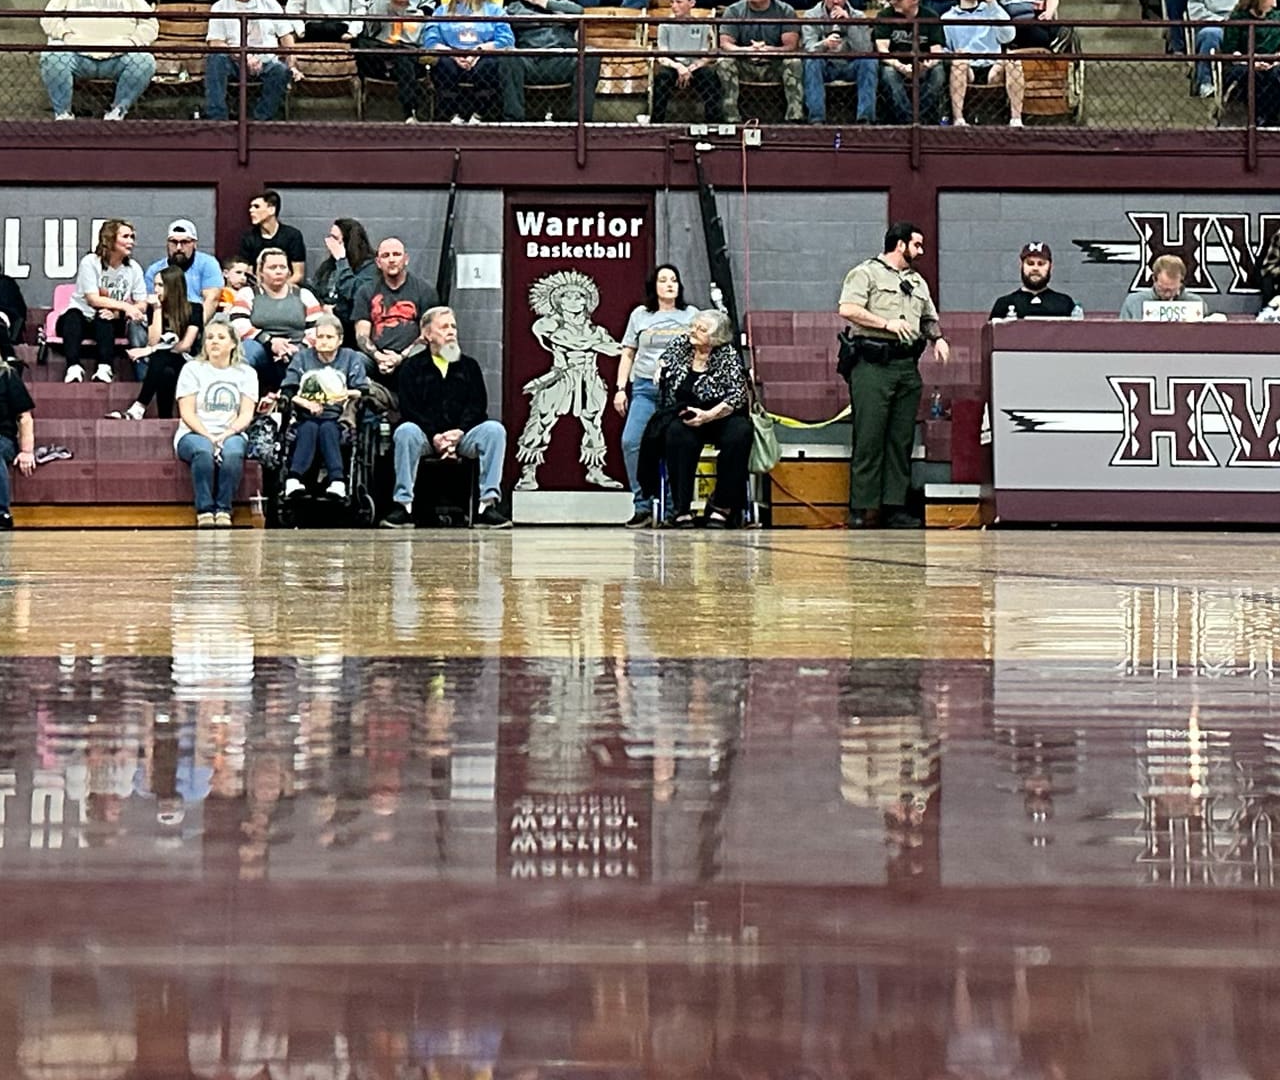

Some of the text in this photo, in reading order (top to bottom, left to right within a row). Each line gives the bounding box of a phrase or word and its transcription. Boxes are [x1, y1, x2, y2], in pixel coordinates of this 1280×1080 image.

[515, 210, 644, 238] Warrior
[526, 241, 632, 259] Basketball
[472, 267, 482, 280] 1
